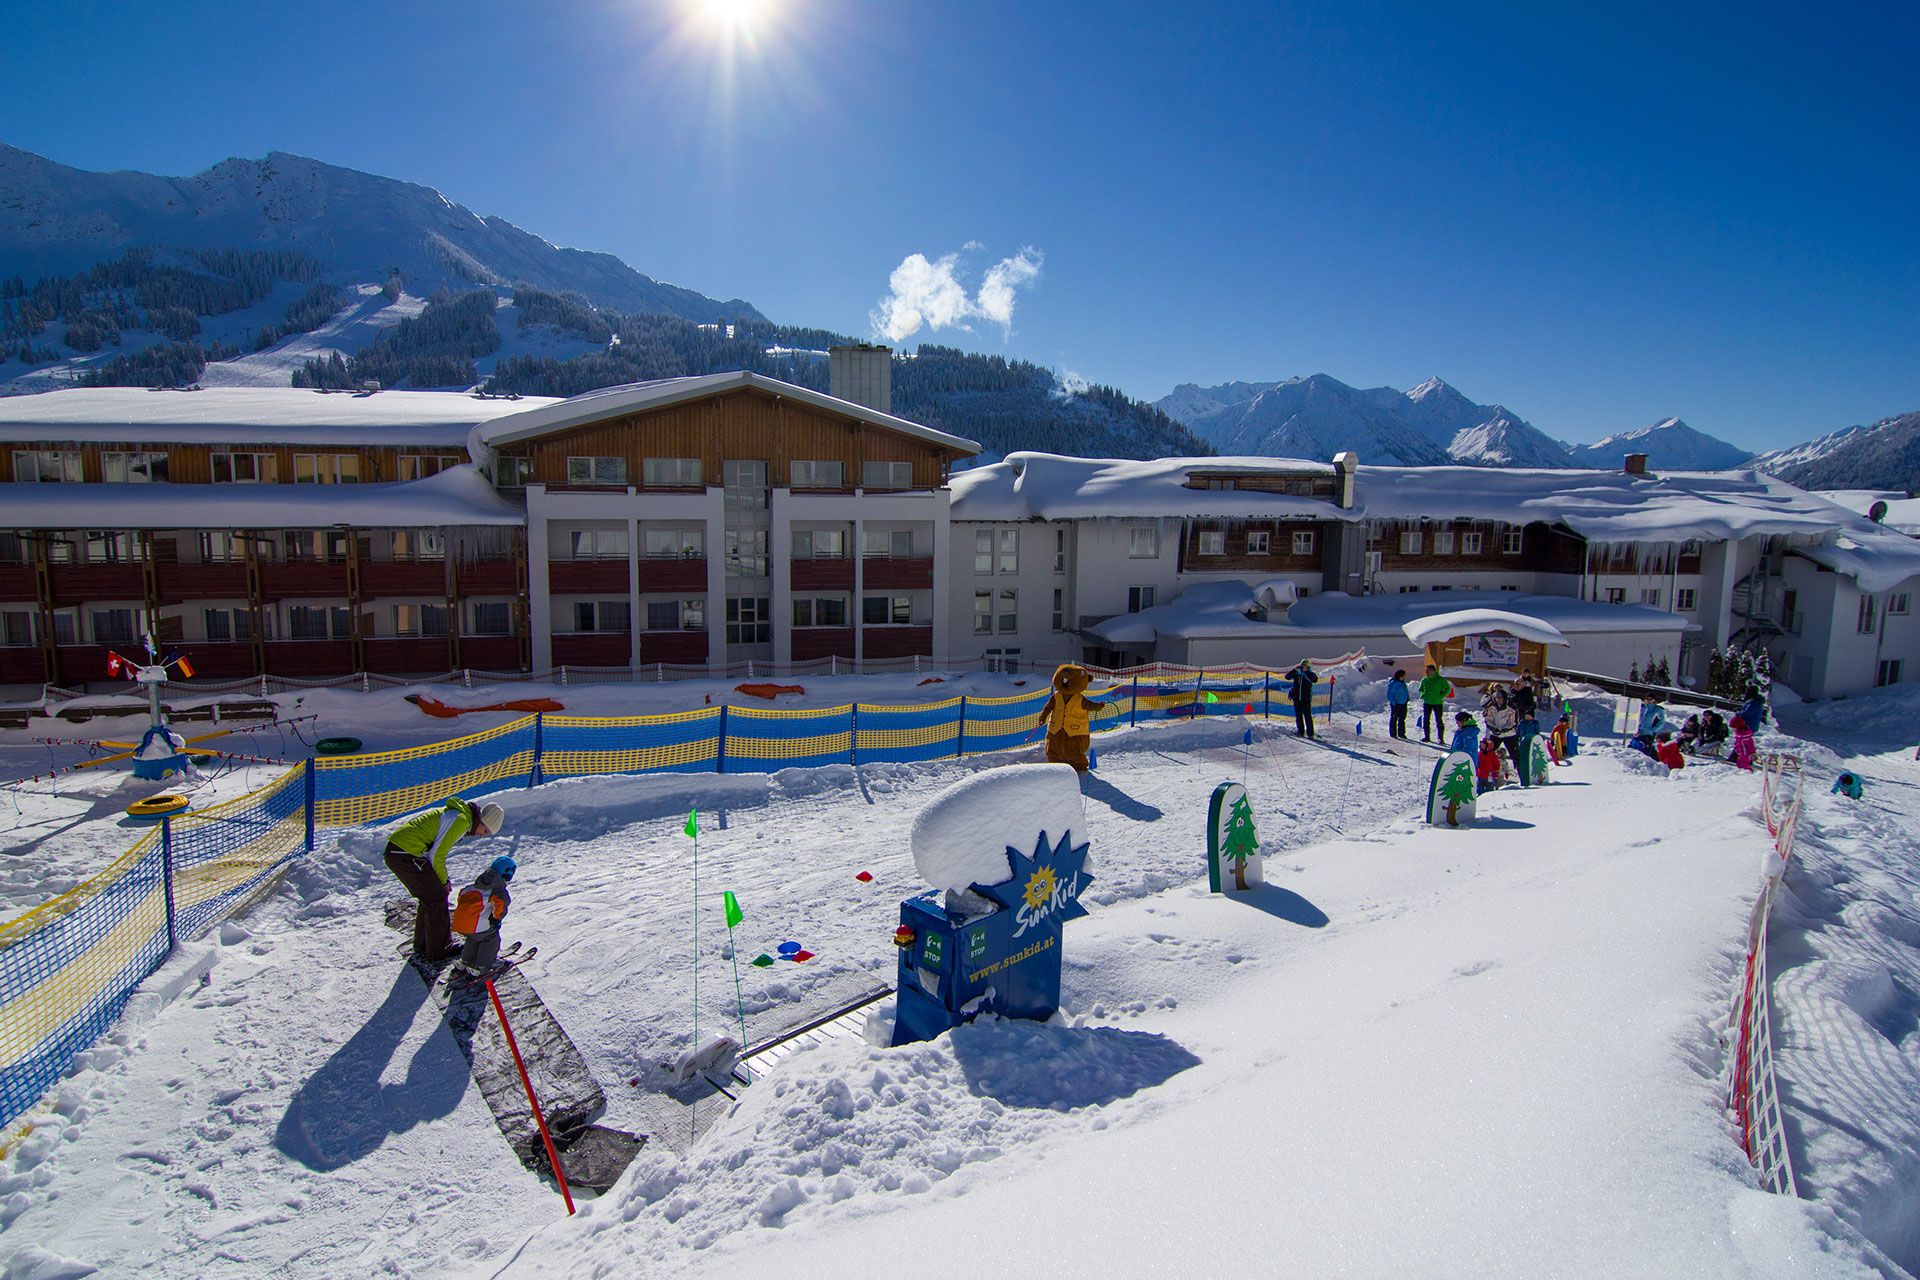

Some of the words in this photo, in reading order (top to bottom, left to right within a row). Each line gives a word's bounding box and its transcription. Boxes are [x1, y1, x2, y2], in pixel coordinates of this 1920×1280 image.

[924, 950, 941, 963] STOP
[970, 946, 986, 958] STOP
[969, 936, 1054, 983] www.sunkid.at
